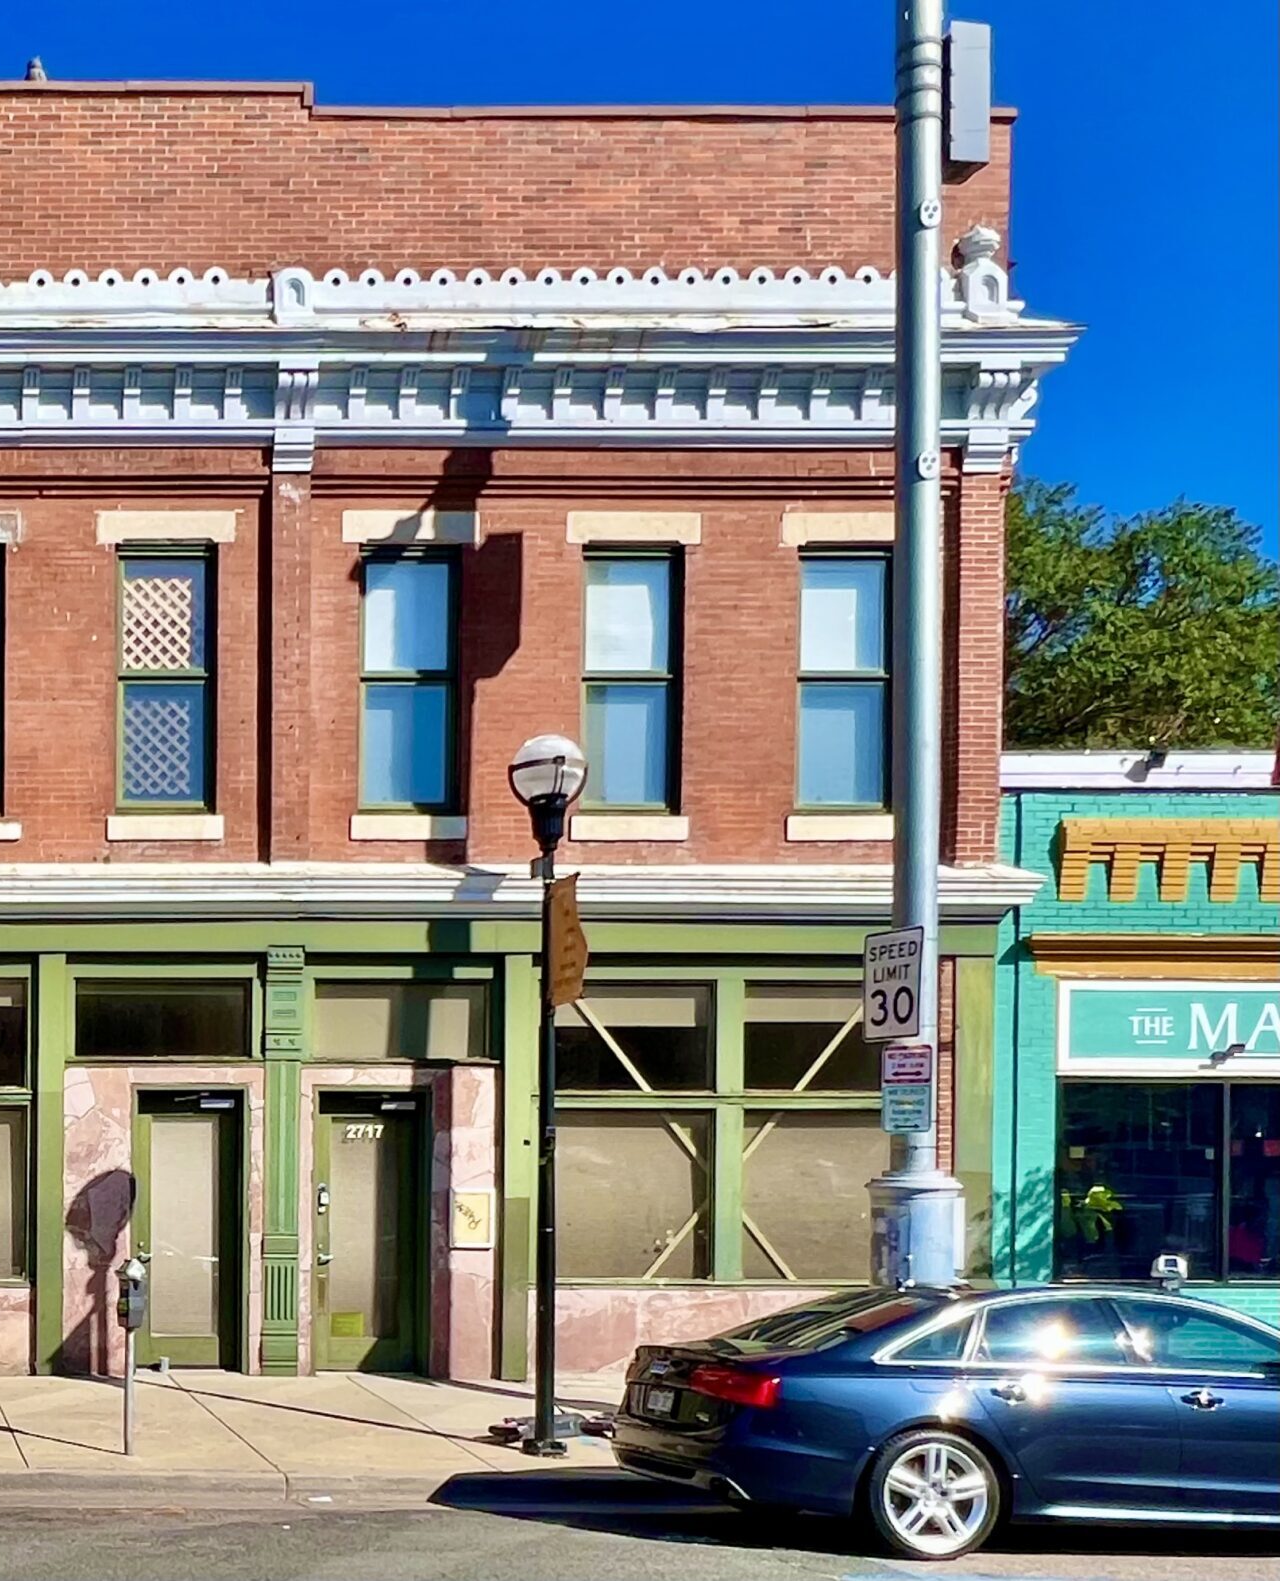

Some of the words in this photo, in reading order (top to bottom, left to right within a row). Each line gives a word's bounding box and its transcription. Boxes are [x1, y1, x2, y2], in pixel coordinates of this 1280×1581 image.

[869, 941, 918, 962] SPEED
[873, 964, 911, 984] LIMIT
[870, 986, 914, 1027] 30
[1128, 1015, 1175, 1036] THE
[346, 1124, 385, 1139] 2717
